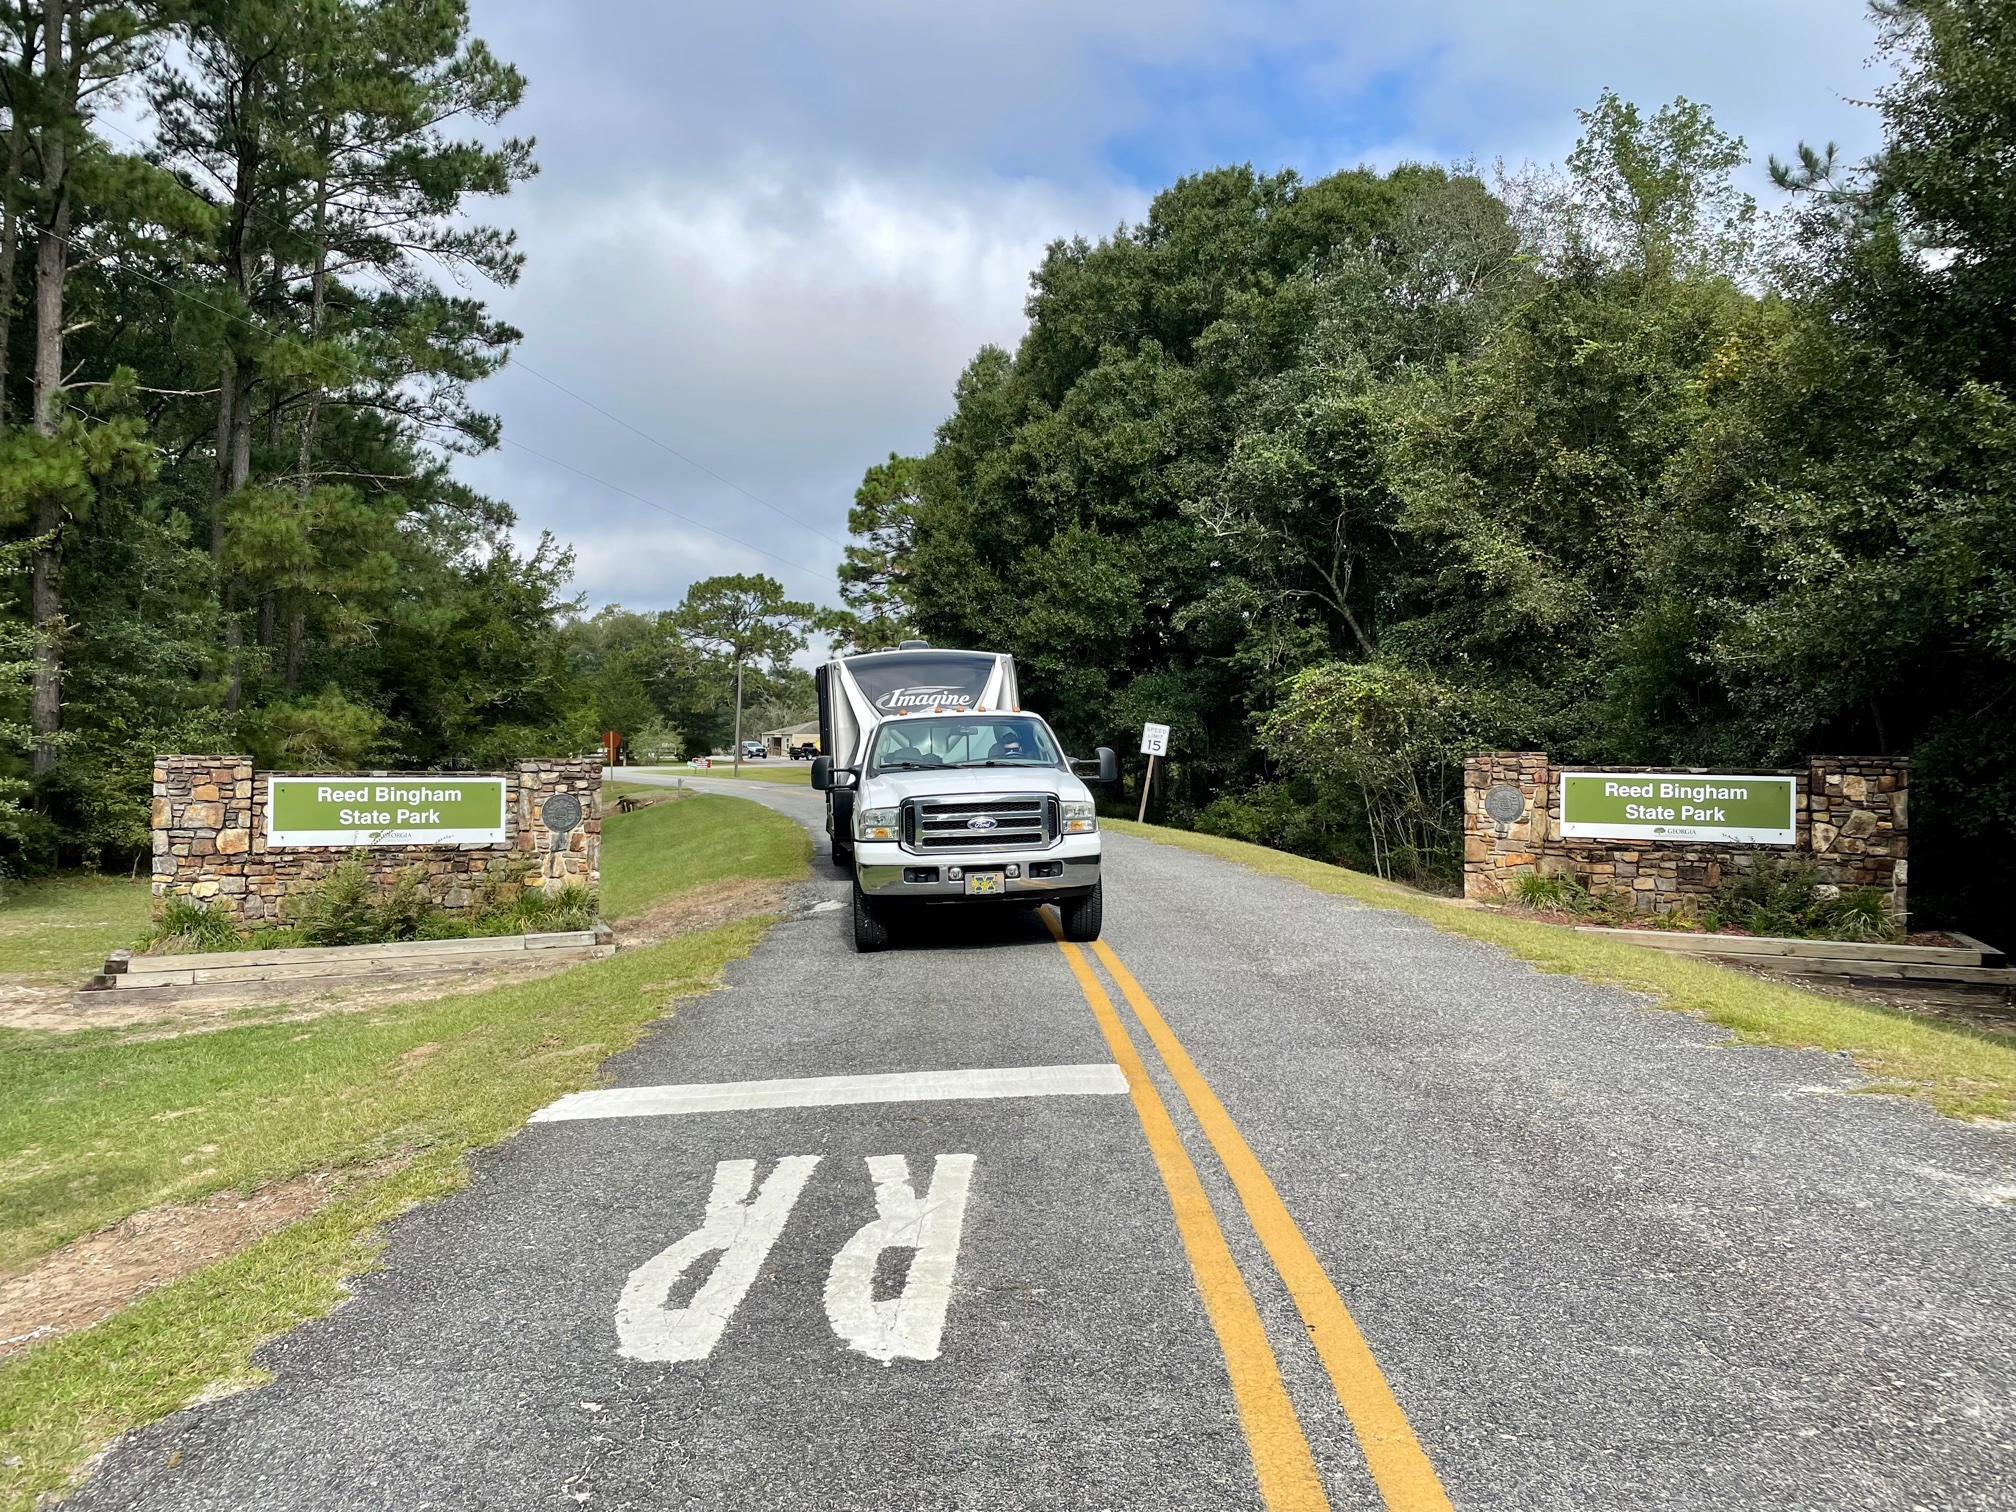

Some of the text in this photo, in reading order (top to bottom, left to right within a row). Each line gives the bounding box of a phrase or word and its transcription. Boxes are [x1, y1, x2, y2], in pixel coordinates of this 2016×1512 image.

[885, 688, 974, 709] Imagine
[1146, 726, 1167, 734] SPEED
[1147, 739, 1162, 752] 15
[317, 786, 462, 806] Reed Bingham
[1604, 781, 1748, 803] Reed Bingham
[339, 808, 441, 825] State Park
[1625, 803, 1726, 822] State Park
